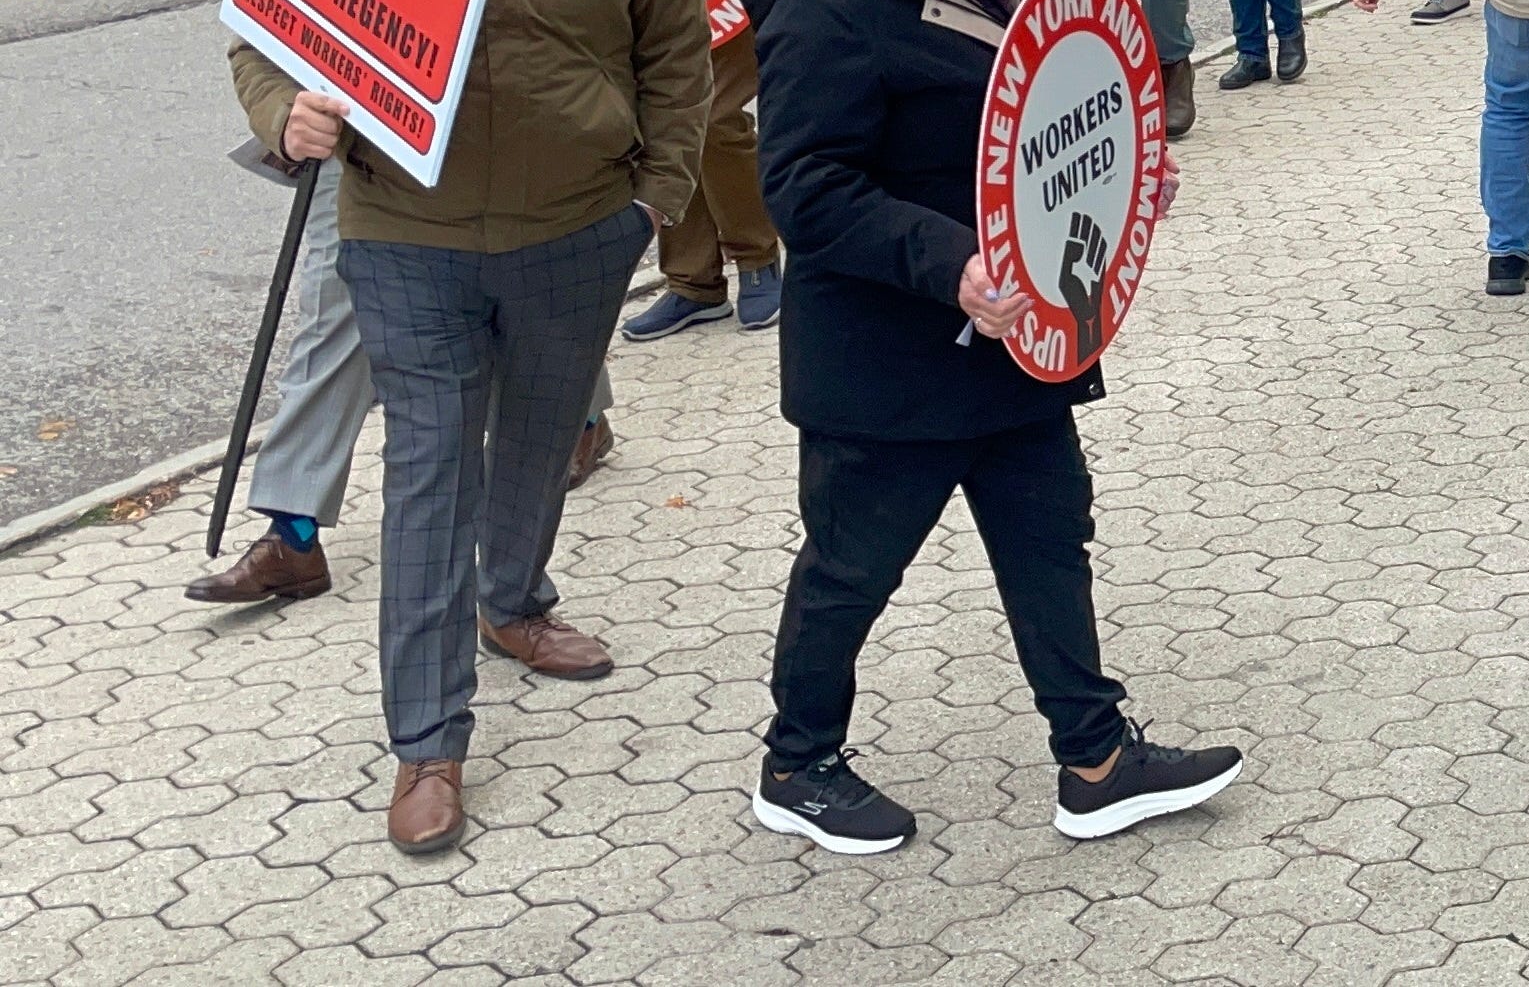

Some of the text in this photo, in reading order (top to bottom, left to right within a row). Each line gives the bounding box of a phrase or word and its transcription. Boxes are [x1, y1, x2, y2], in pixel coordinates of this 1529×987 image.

[300, 23, 369, 88] WORKERS'
[369, 80, 426, 139] RIGHTS!
[987, 43, 1027, 185] NEW
[1021, 81, 1123, 175] WORKERS
[1042, 136, 1115, 212] UNITED
[1109, 69, 1160, 325] VERMONT
[986, 203, 1067, 372] UPSATE
